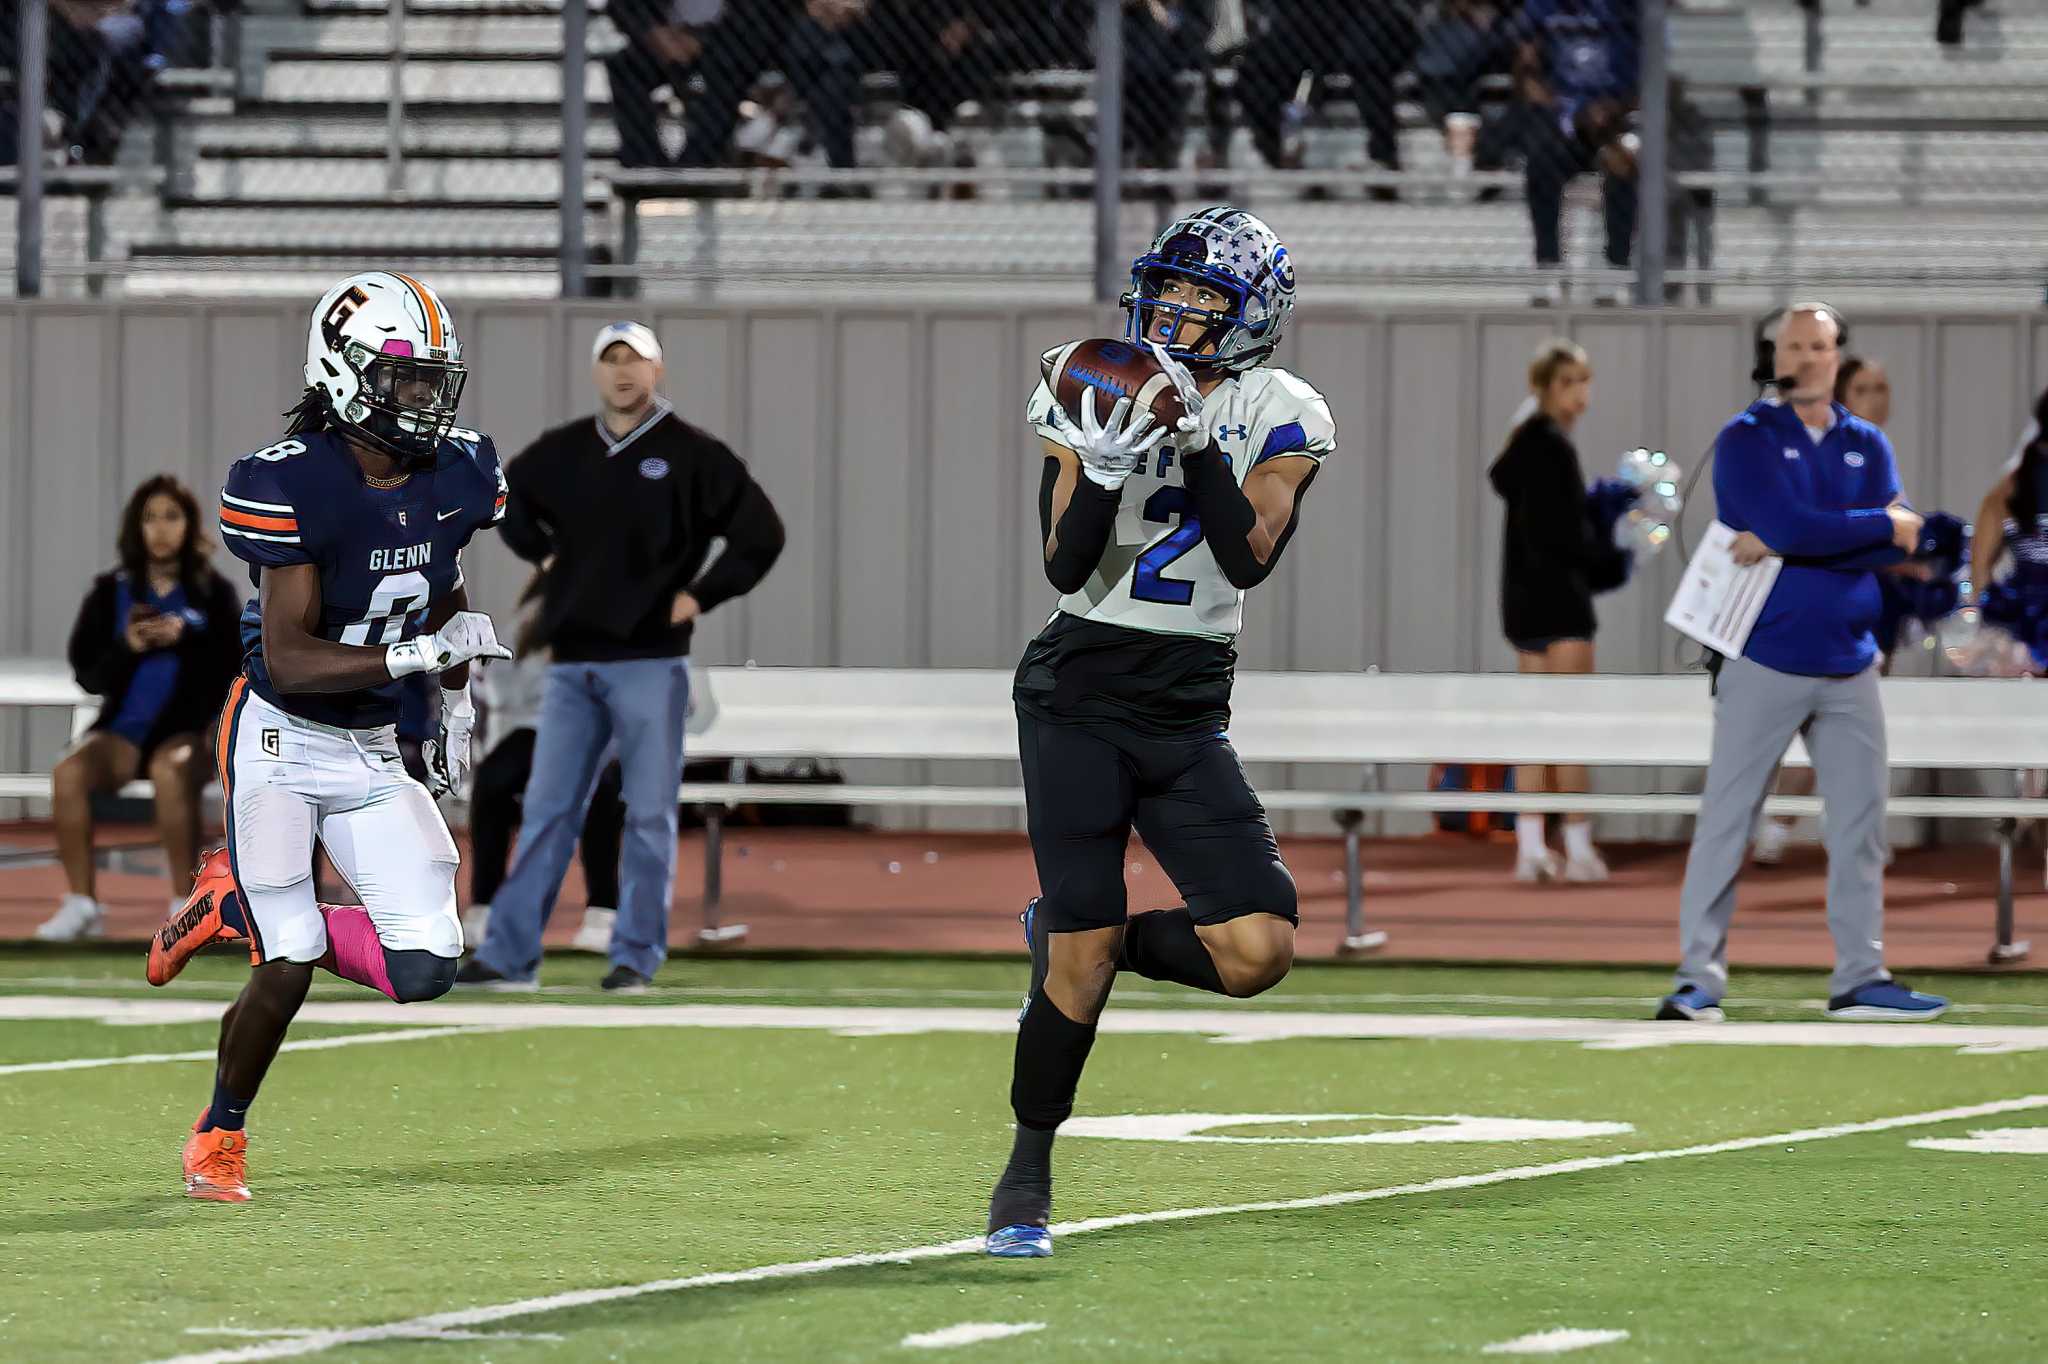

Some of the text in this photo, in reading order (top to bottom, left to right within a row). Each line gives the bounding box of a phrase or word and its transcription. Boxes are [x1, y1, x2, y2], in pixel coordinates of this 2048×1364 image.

[254, 439, 307, 462] 8
[369, 541, 432, 571] GLENN
[1129, 484, 1205, 606] 2
[262, 728, 280, 757] G
